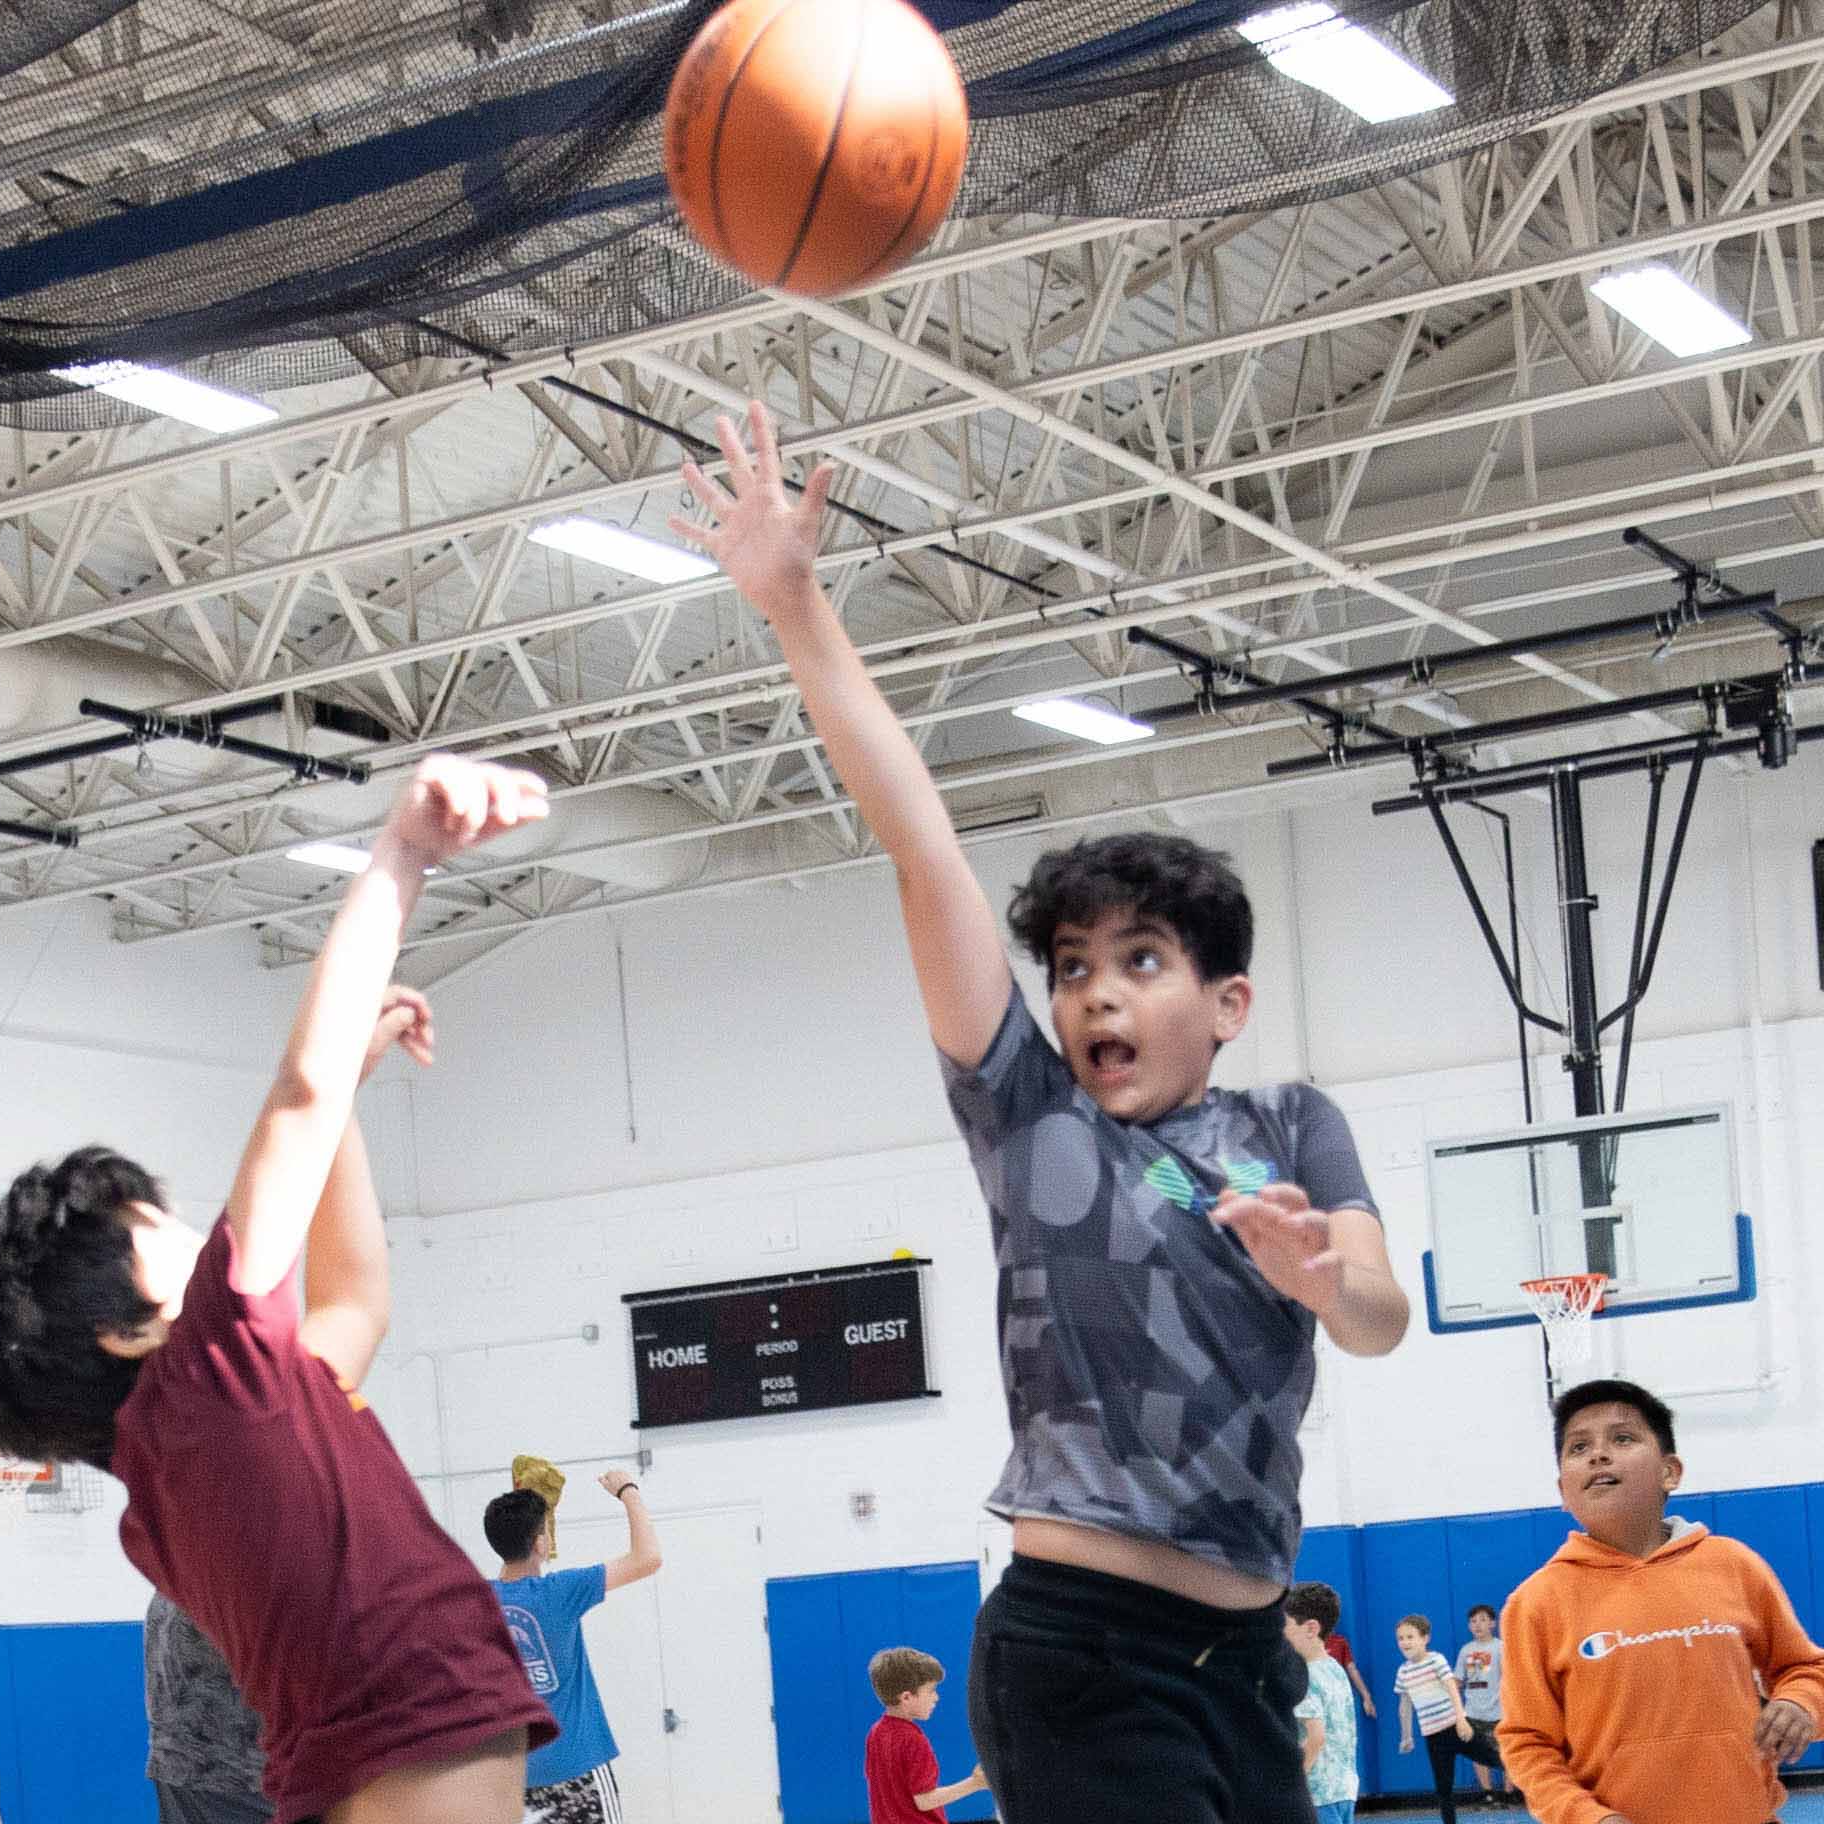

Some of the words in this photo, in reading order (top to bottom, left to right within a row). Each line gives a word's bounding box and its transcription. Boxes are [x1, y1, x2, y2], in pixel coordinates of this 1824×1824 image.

[844, 1319, 909, 1345] GUEST
[648, 1345, 708, 1369] HOME
[755, 1339, 798, 1357] PERIOD
[1577, 1617, 1740, 1660] Champion
